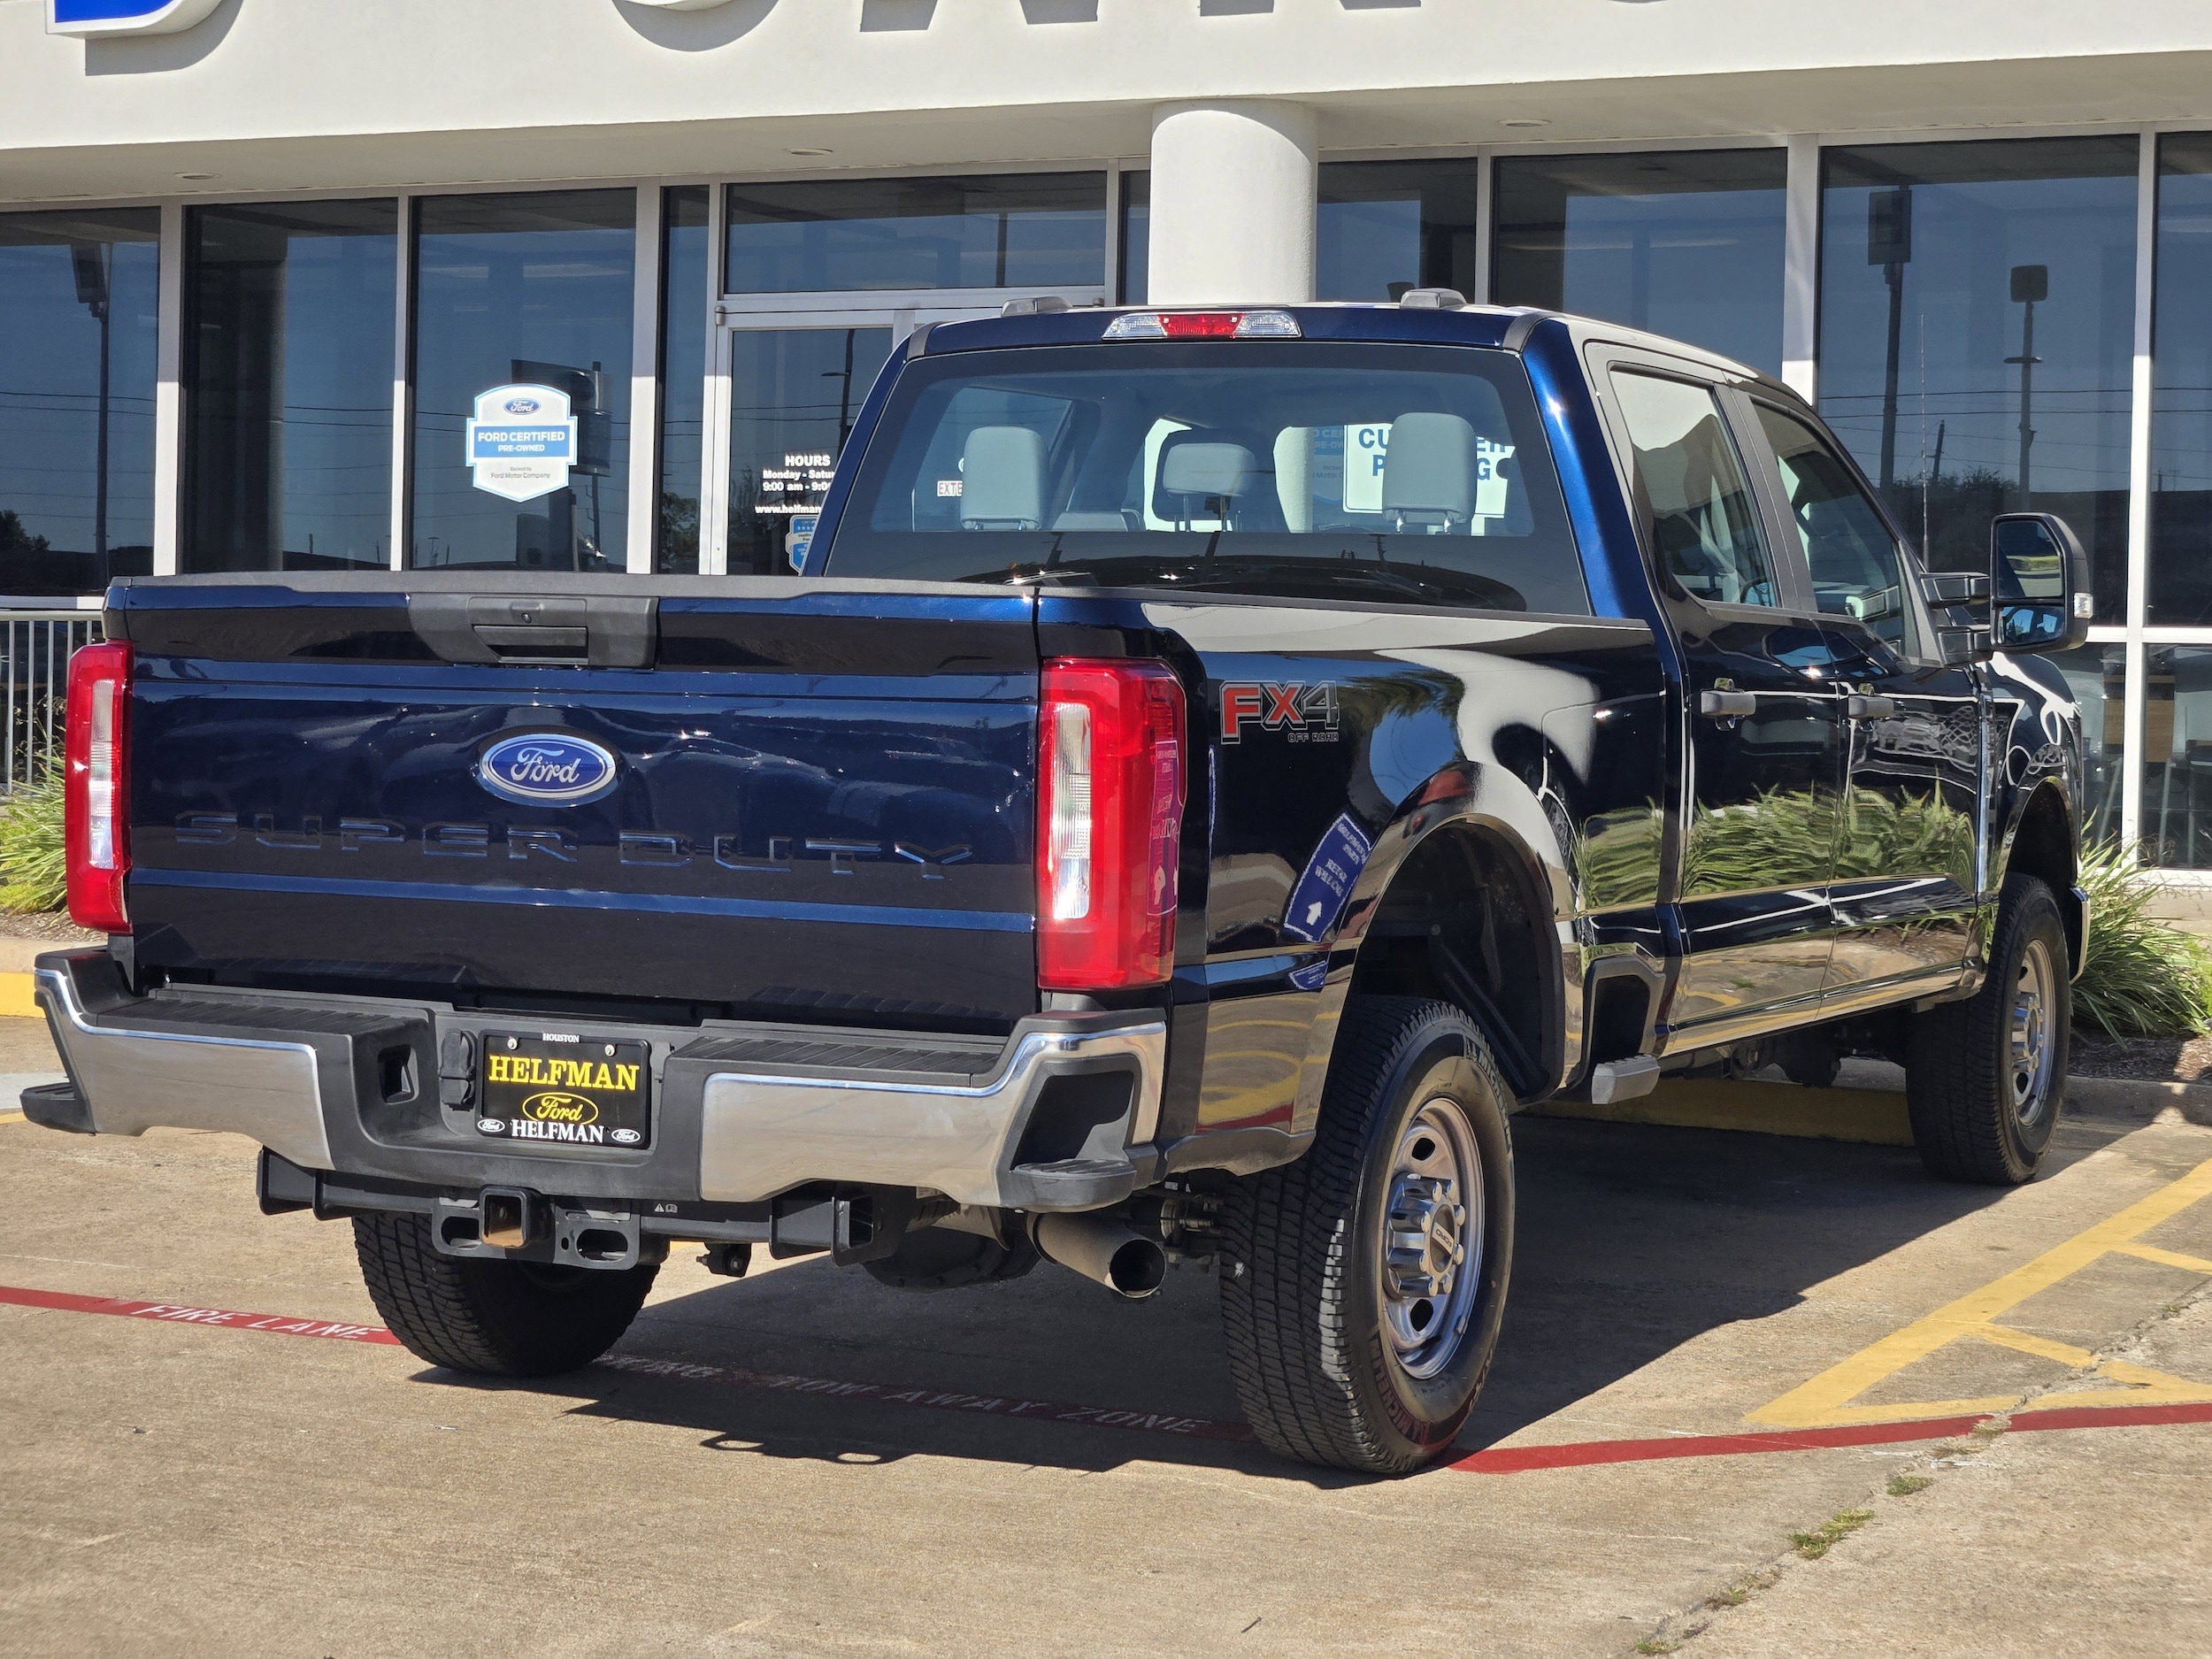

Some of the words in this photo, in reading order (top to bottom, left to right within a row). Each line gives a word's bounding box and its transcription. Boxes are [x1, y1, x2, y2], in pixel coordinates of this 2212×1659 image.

[478, 432, 508, 442] FORD
[510, 431, 565, 442] CERTIFIED
[785, 455, 831, 467] HOURS
[523, 472, 550, 480] Company
[763, 470, 801, 480] Monday
[763, 482, 784, 491] 9:00
[1219, 680, 1340, 744] FX4
[1287, 733, 1310, 743] OFF
[1312, 732, 1339, 742] ROAD
[175, 810, 580, 864] SUPER
[618, 829, 972, 879] DUTY
[542, 1033, 580, 1043] HOUSTON
[488, 1055, 640, 1091] HELFMAN
[511, 1118, 605, 1143] HELFMAN
[132, 1305, 252, 1324] FIRE
[248, 1317, 388, 1339] LANE
[881, 1390, 1050, 1414] AWAY
[1056, 1407, 1211, 1432] ZONE
